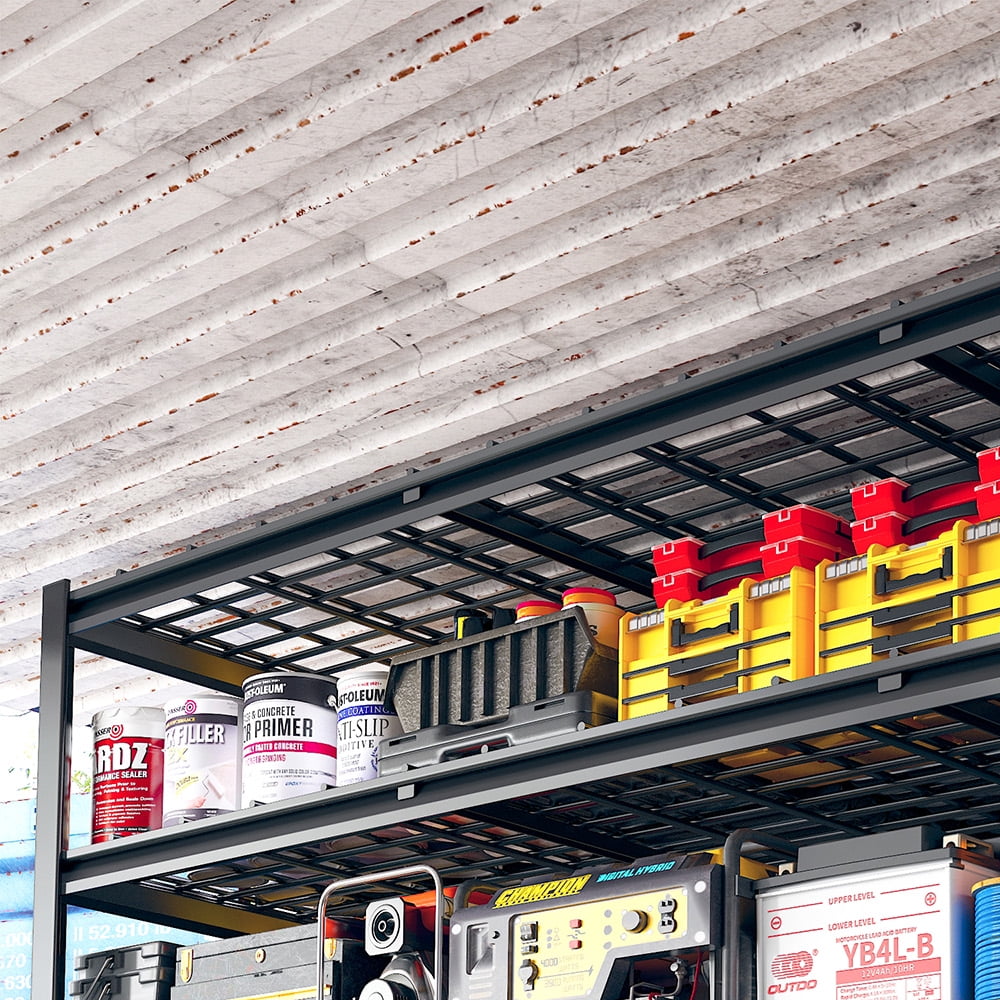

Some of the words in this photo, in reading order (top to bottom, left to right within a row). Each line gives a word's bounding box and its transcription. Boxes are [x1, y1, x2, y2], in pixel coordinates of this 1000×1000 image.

[257, 706, 296, 719] CONCRETE
[177, 724, 226, 746] FILLER
[254, 718, 313, 739] PRIMER
[274, 742, 304, 752] CONCRETE
[96, 742, 149, 775] RDZ
[121, 770, 148, 779] SEALER
[635, 861, 676, 875] HYBRID
[828, 894, 853, 905] UPPER
[853, 891, 875, 902] LEVEL
[828, 920, 853, 931] LOWER
[854, 917, 876, 928] LEVEL
[843, 933, 934, 968] YB4L-B
[767, 979, 818, 995] OUTDO
